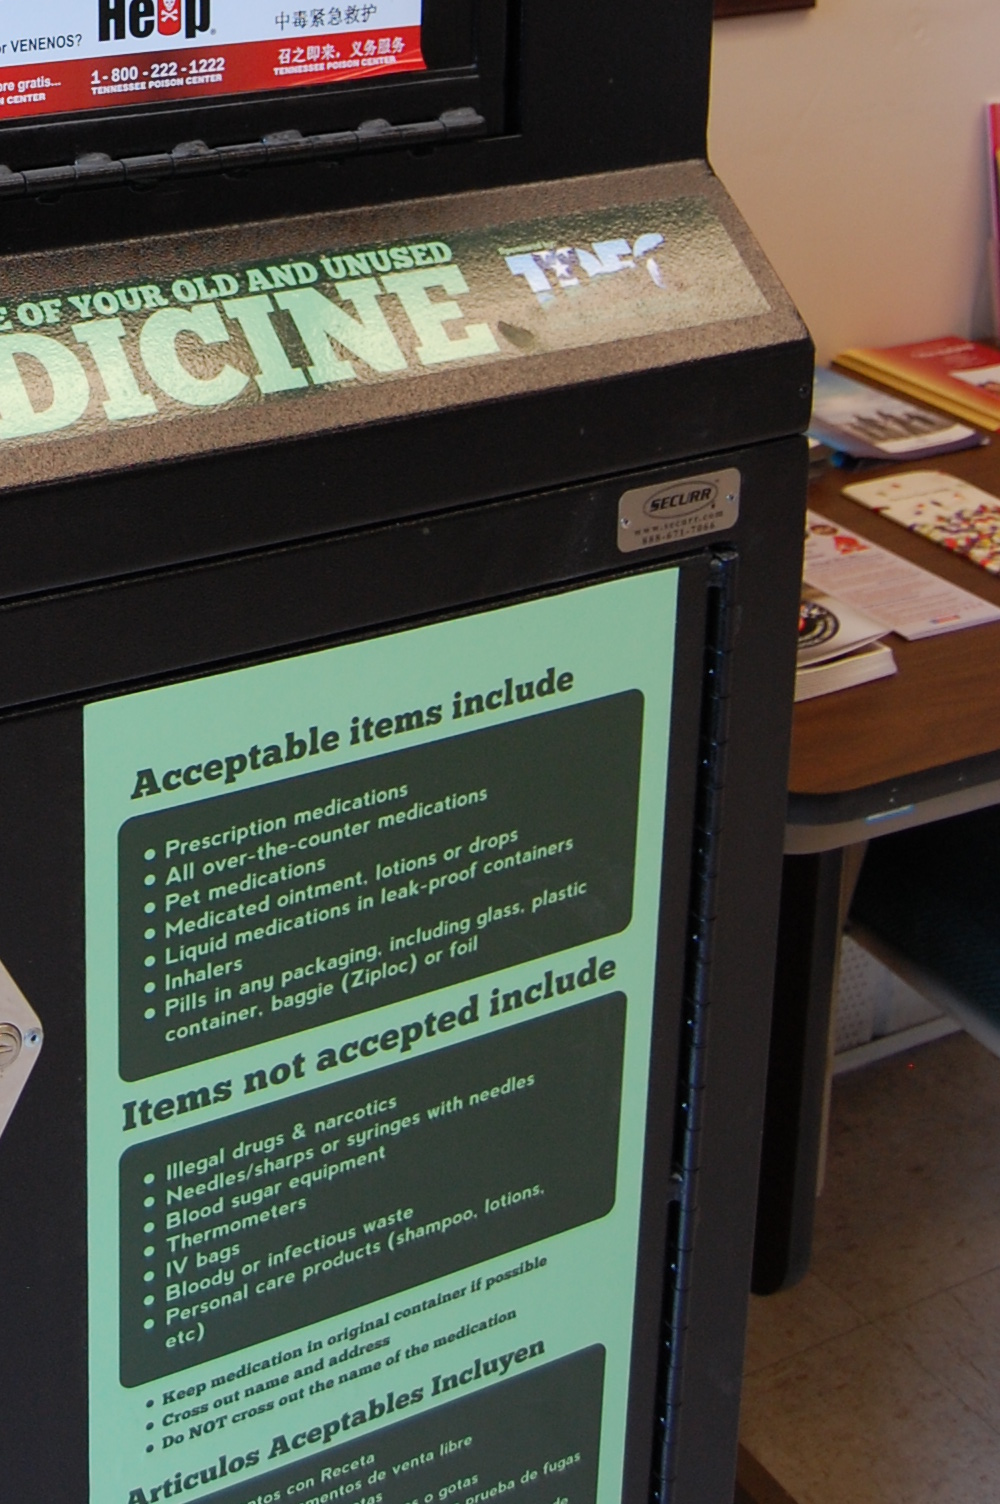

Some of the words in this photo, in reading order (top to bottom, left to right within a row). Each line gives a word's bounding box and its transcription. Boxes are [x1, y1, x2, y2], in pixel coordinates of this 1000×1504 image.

[10, 33, 83, 53] VENENOS?
[275, 4, 377, 31] 中毒紧急救护
[6, 93, 46, 106] CENTER
[17, 75, 62, 94] gratis...
[91, 82, 146, 96] TENNESSEE
[148, 77, 184, 89] POISON
[185, 73, 223, 84] CENTER
[273, 62, 325, 76] TENNESSEE
[327, 59, 359, 70] POISON
[17, 299, 63, 328] OF
[69, 284, 171, 319] YOUR
[171, 273, 240, 303] OLD
[248, 261, 319, 293] AND
[320, 241, 454, 281] UNUSED
[650, 488, 712, 512] SECURR
[130, 726, 340, 799] Acceptable
[350, 703, 442, 745] items
[452, 667, 574, 719] include
[165, 816, 286, 859] Prescription
[294, 784, 409, 825] medications
[165, 862, 194, 885] All
[203, 818, 370, 875] over-the-counter
[378, 788, 487, 829] medications
[165, 895, 270, 938] Medicated
[277, 871, 368, 907] ointment,
[376, 853, 436, 881] lotions
[443, 846, 461, 861] or
[469, 830, 518, 854] drops
[165, 890, 200, 912] Pet
[208, 859, 326, 900] medications
[165, 933, 227, 964] Liquid
[235, 901, 350, 945] medications
[357, 896, 374, 911] in
[381, 861, 478, 904] leak-proof
[483, 838, 573, 874] containers
[165, 993, 207, 1017] Pills
[215, 987, 232, 1002] in
[239, 976, 274, 995] any
[390, 916, 470, 951] including
[531, 881, 587, 913] plastic
[165, 958, 243, 991] Inhalers
[271, 982, 334, 1011] baggie
[341, 954, 417, 993] (Ziploc)
[424, 950, 443, 966] or
[450, 934, 478, 958] foil
[122, 1079, 232, 1132] Items
[244, 1053, 306, 1094] not
[316, 994, 479, 1071] accepted
[489, 956, 617, 1017] include
[166, 1148, 224, 1181] Illegal
[232, 1133, 285, 1160] drugs
[292, 1123, 306, 1140] &
[315, 1097, 397, 1133] narcotics
[166, 1148, 314, 1205] Needles/sharps
[321, 1139, 340, 1155] or
[347, 1112, 420, 1147] syringes
[427, 1096, 463, 1120] with
[469, 1073, 535, 1106] needles
[166, 1197, 224, 1230] Blood
[231, 1182, 282, 1208] sugar
[289, 1146, 385, 1188] equipment
[166, 1198, 307, 1252] Thermometers
[166, 1268, 234, 1302] Bloody
[241, 1259, 261, 1276] or
[268, 1226, 357, 1267] infectious
[363, 1207, 413, 1234] waste
[166, 1256, 188, 1278] IV
[196, 1243, 240, 1268] bags
[166, 1284, 248, 1326] Personal
[255, 1272, 295, 1294] care
[302, 1240, 381, 1282] products
[162, 1383, 207, 1406] Keep
[210, 1347, 303, 1389] medication
[307, 1340, 323, 1354] in
[327, 1312, 390, 1346] original
[393, 1286, 467, 1322] container
[470, 1277, 484, 1293] if
[485, 1255, 548, 1291] possible
[165, 1322, 205, 1348] etc)
[161, 1432, 185, 1449] Do
[188, 1415, 229, 1440] NOT
[231, 1401, 275, 1424] cross
[278, 1388, 305, 1407] out
[308, 1378, 335, 1396] the
[338, 1361, 382, 1385] name
[385, 1350, 401, 1367] of
[405, 1342, 430, 1360] the
[433, 1308, 517, 1349] medication
[162, 1403, 209, 1428] Cross
[213, 1390, 240, 1409] out
[244, 1374, 290, 1398] name
[293, 1357, 325, 1380] and
[328, 1335, 391, 1367] address
[127, 1448, 260, 1504] Articulos
[267, 1386, 424, 1459] Aceptables
[431, 1339, 546, 1398] Incluyen
[286, 1478, 315, 1495] con
[320, 1453, 376, 1483] Receta
[367, 1469, 387, 1485] de
[392, 1451, 434, 1475] venta
[439, 1435, 473, 1457] libre
[438, 1474, 479, 1500] gotas
[520, 1469, 538, 1484] de
[542, 1451, 582, 1475] fugas
